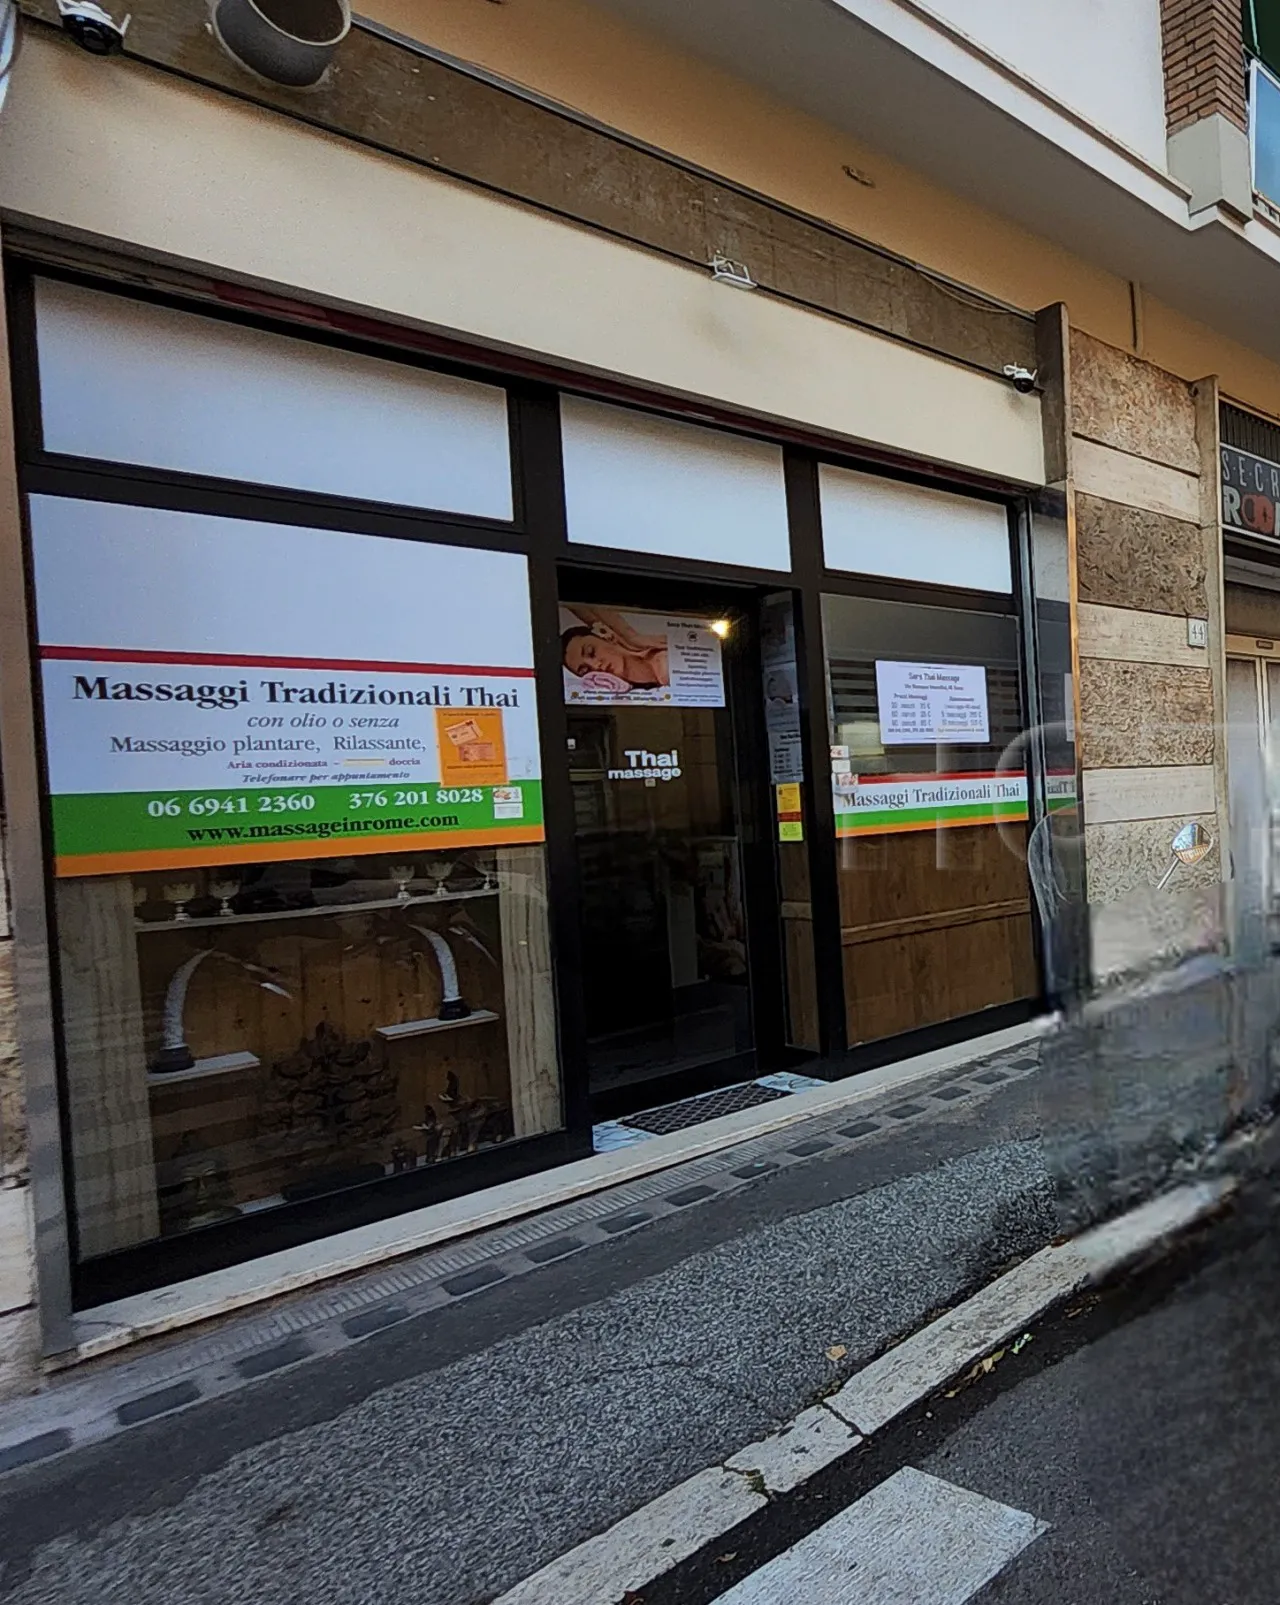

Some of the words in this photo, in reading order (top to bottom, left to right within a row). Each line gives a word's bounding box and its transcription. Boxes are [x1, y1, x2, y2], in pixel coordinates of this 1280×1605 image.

[72, 675, 250, 710] Massaggi
[260, 680, 452, 707] Tradizionali
[460, 686, 520, 708] Thai
[247, 715, 284, 728] con
[290, 713, 326, 728] olio
[333, 716, 344, 728] o
[349, 715, 400, 728] senza
[109, 736, 226, 757] Massaggio
[233, 735, 321, 756] plantare,
[333, 735, 426, 753] Rilassante,
[227, 760, 253, 769] Aria
[255, 759, 328, 769] condizionata
[389, 758, 421, 767] doccia
[624, 749, 679, 767] Thai
[243, 773, 306, 784] Telefonare
[308, 774, 328, 783] per
[331, 771, 410, 782] appuntamento
[608, 767, 682, 781] massage
[148, 797, 181, 817] 06
[188, 796, 249, 817] 6941
[257, 792, 315, 812] 2360
[349, 790, 388, 809] 376
[393, 790, 429, 806] 201
[436, 788, 484, 804] 8028
[842, 789, 910, 809] Massaggi
[912, 783, 991, 803] Tradizionali
[994, 782, 1020, 798] Thai
[186, 814, 459, 841] www.massageinrome.com
